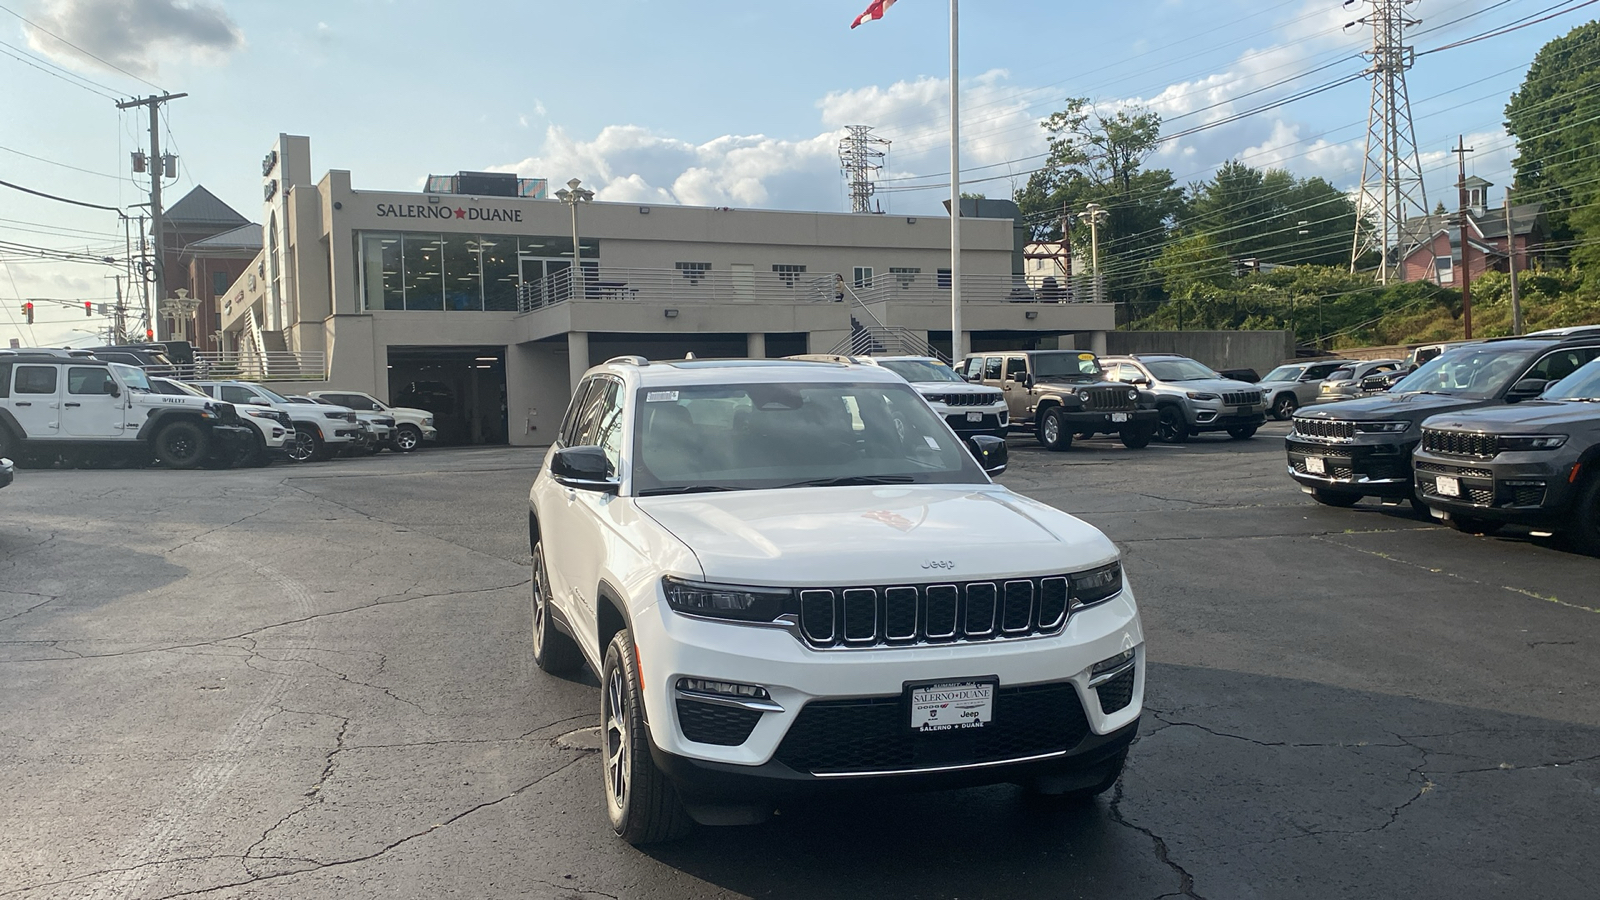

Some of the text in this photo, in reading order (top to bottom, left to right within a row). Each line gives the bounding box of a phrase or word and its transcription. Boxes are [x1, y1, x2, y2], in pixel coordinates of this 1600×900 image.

[377, 204, 523, 222] SALERNO DUANE
[921, 559, 955, 570] Jeep
[914, 689, 990, 703] SALERNO DUANE
[961, 721, 984, 729] DUANE
